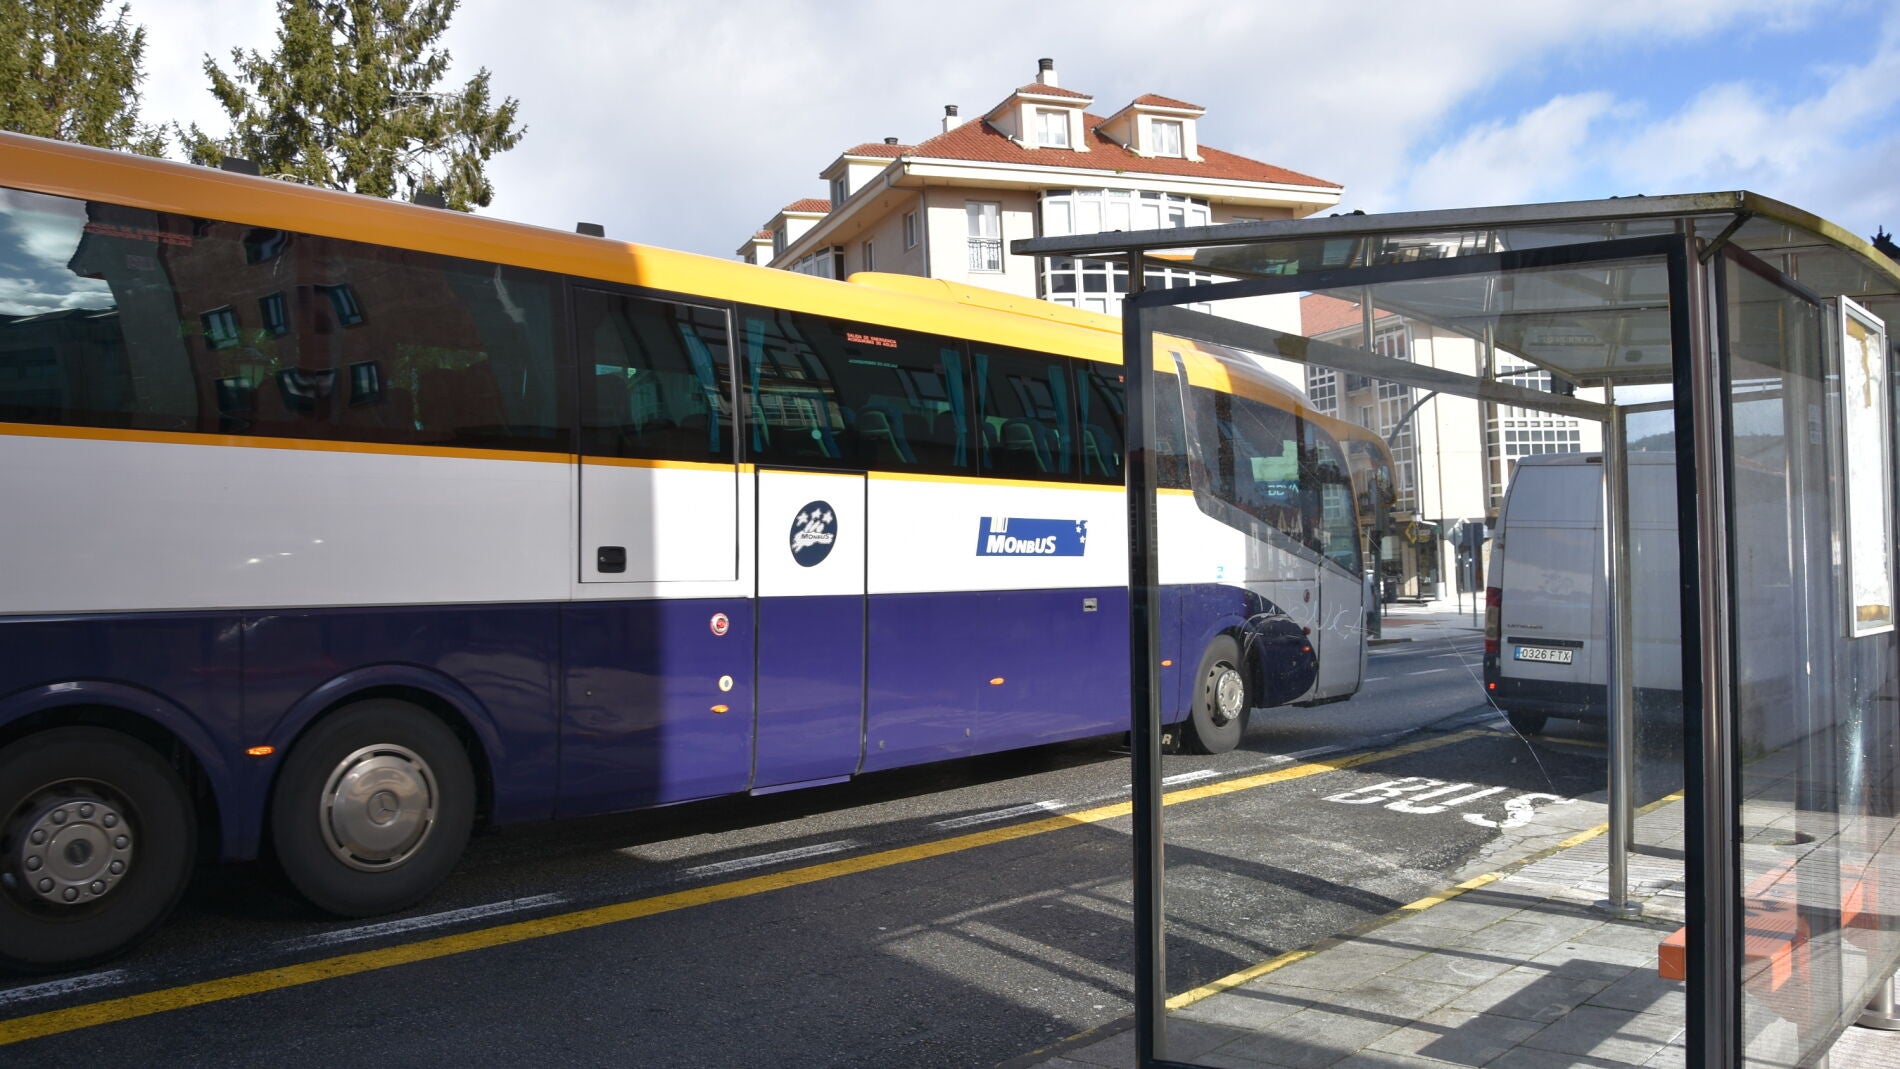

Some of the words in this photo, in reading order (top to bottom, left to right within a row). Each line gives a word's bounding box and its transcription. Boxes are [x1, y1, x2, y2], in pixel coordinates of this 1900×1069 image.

[986, 534, 1057, 554] MONBUS
[1521, 648, 1547, 660] 0326
[1549, 650, 1570, 662] FTX
[1321, 776, 1579, 829] BUS
